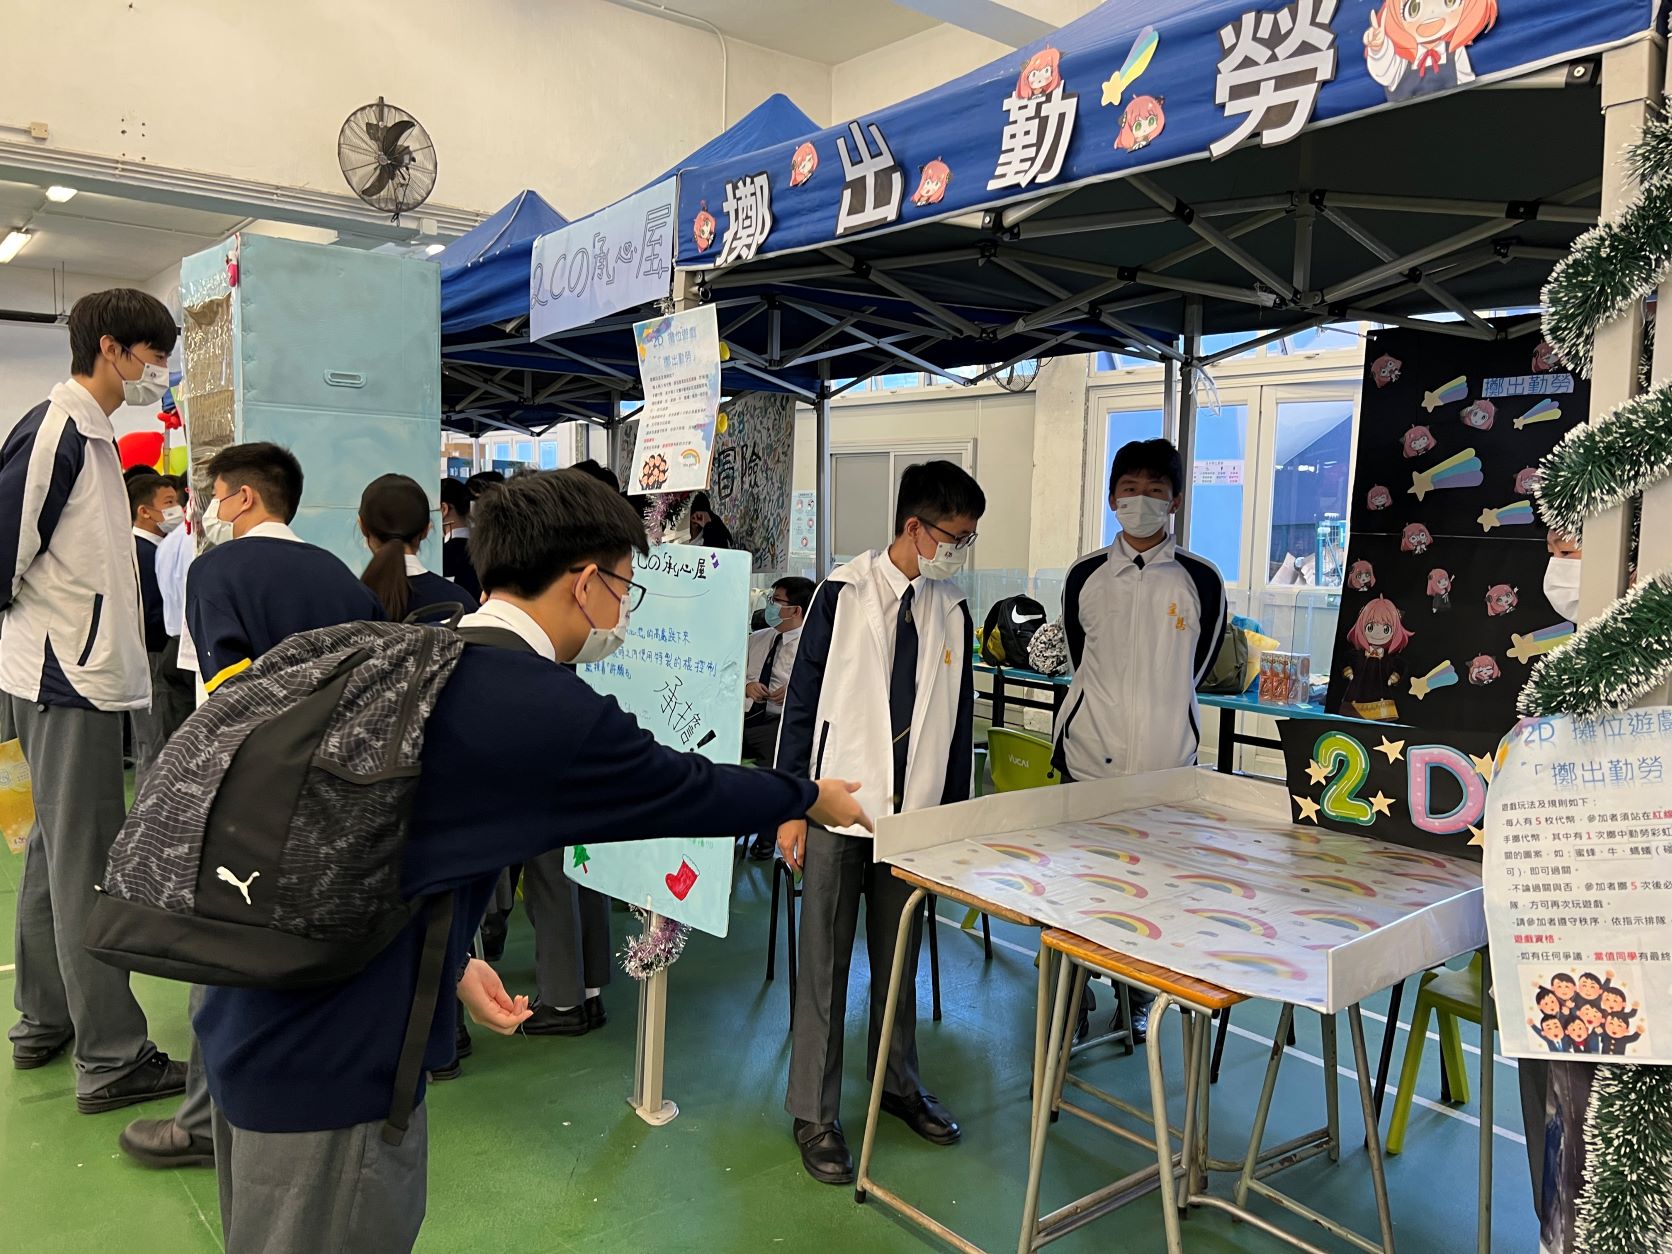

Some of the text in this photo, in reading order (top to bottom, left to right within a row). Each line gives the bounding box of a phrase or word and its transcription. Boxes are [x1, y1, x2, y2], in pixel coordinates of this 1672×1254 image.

[715, 0, 1338, 268] 擲出勤勞
[1485, 374, 1571, 397] 擲出勤勞
[1523, 722, 1555, 745] 2D
